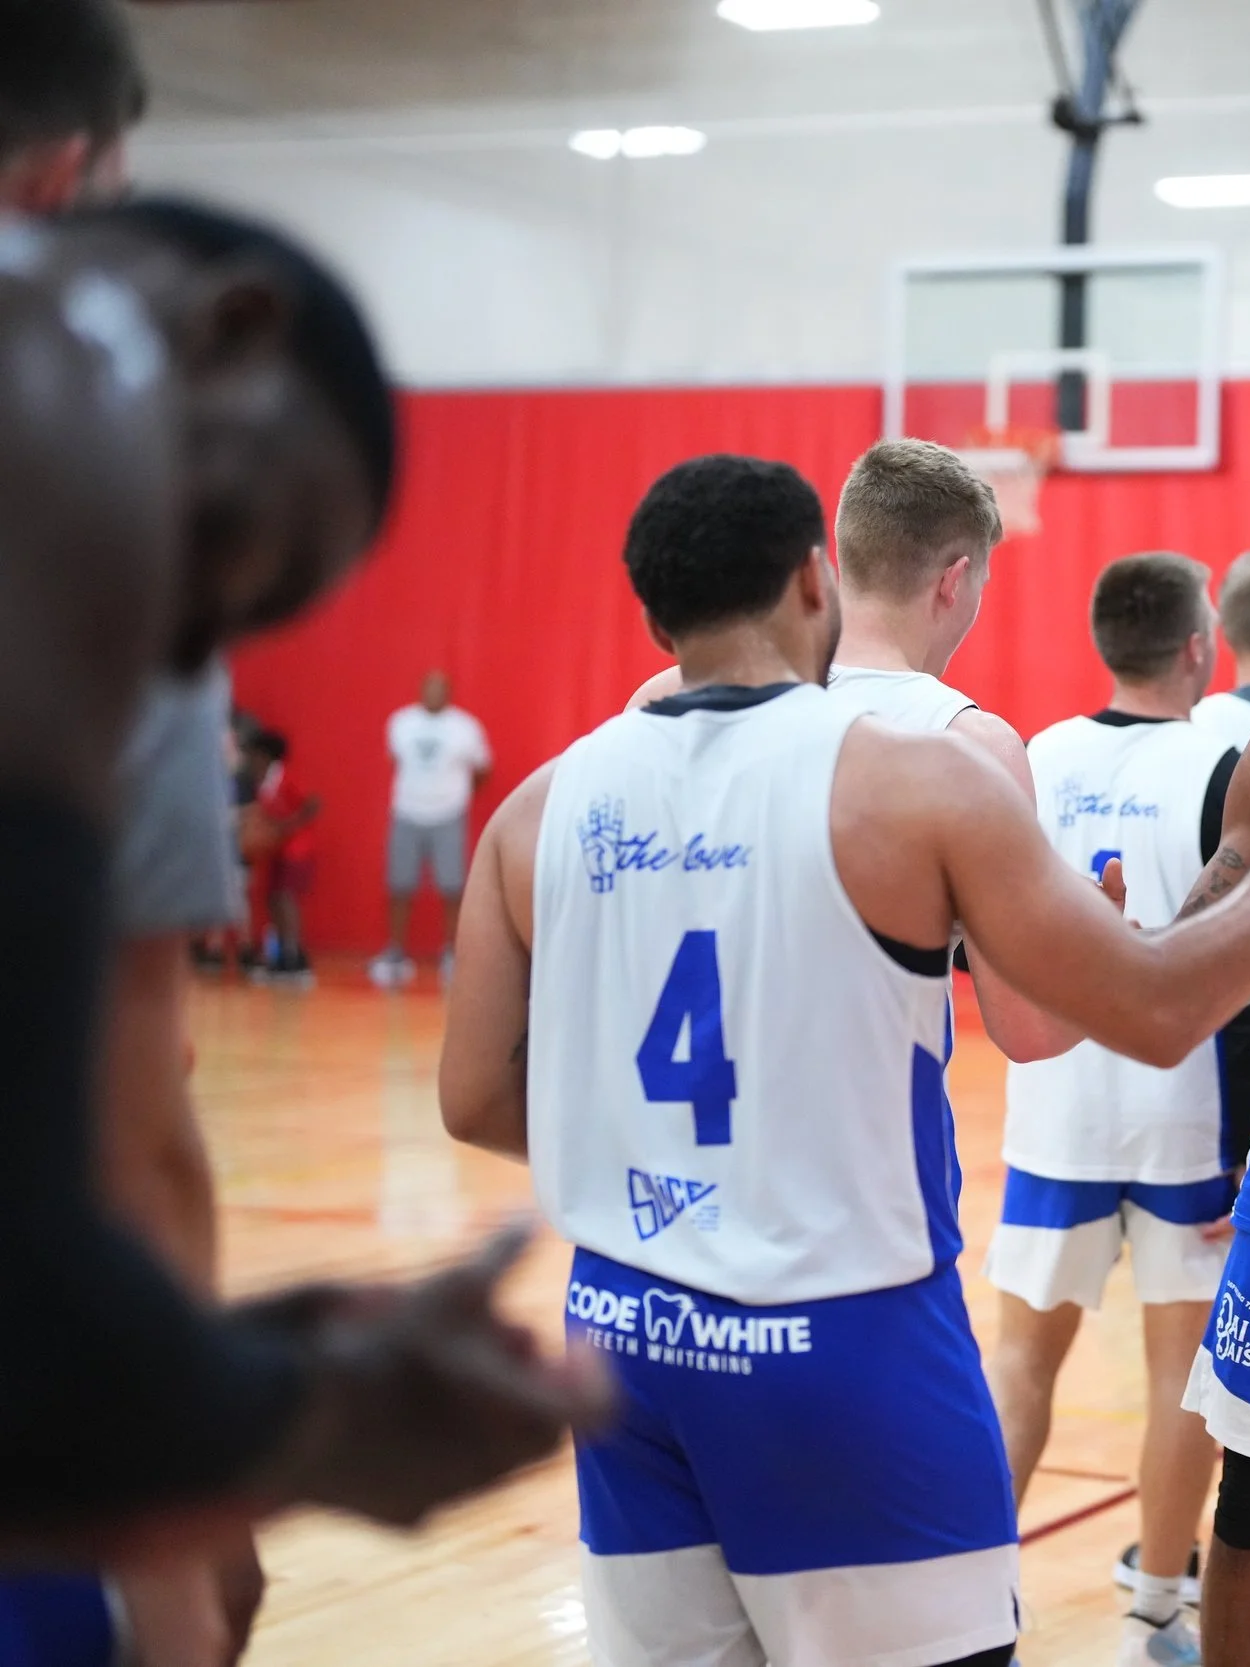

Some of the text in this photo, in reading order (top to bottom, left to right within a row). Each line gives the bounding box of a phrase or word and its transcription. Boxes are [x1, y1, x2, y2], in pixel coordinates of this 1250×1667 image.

[616, 830, 679, 871] the
[635, 930, 738, 1146] 4
[567, 1281, 812, 1353] CODE WHITE
[586, 1327, 752, 1375] TEETH WHITENING
